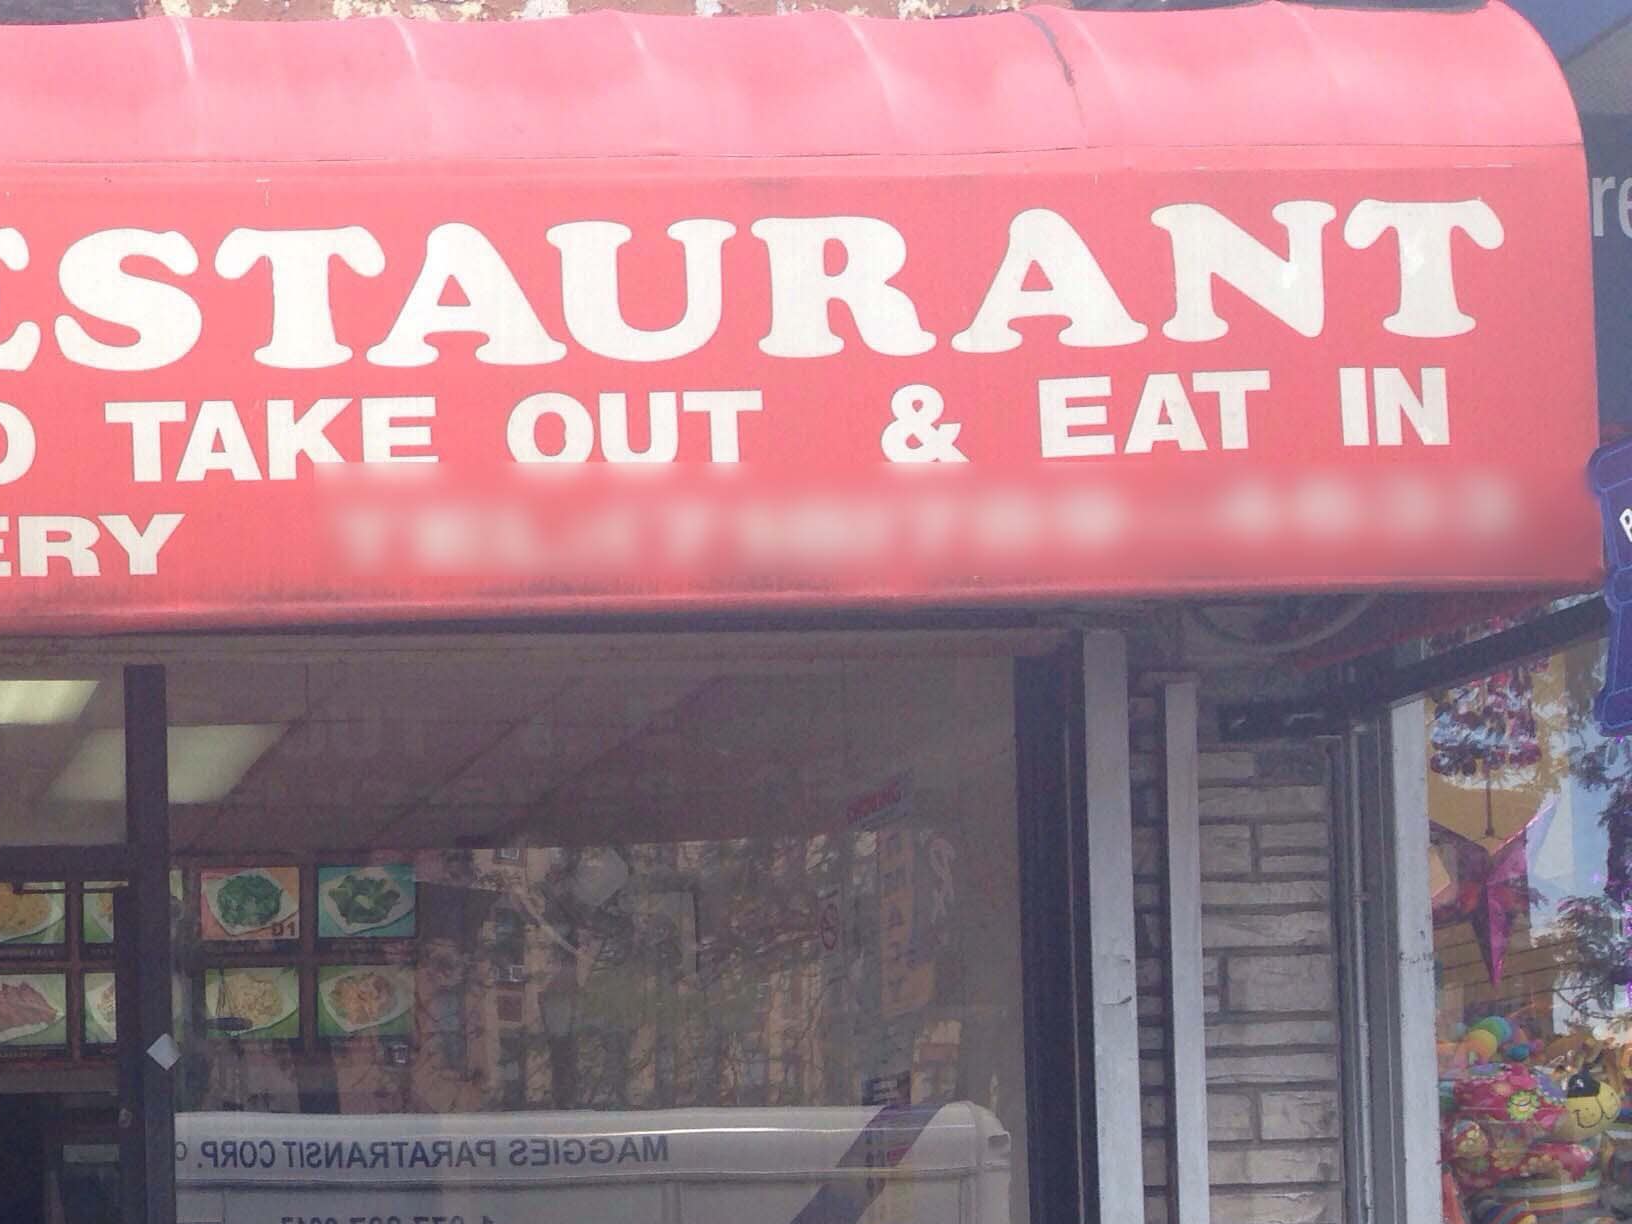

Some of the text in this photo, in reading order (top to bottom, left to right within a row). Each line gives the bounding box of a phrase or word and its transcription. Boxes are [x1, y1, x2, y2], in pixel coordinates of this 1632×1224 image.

[104, 395, 440, 483] TAKE
[506, 389, 763, 465] OUT
[880, 384, 969, 465] &
[1038, 370, 1271, 459] EAT
[1339, 366, 1450, 446] IN
